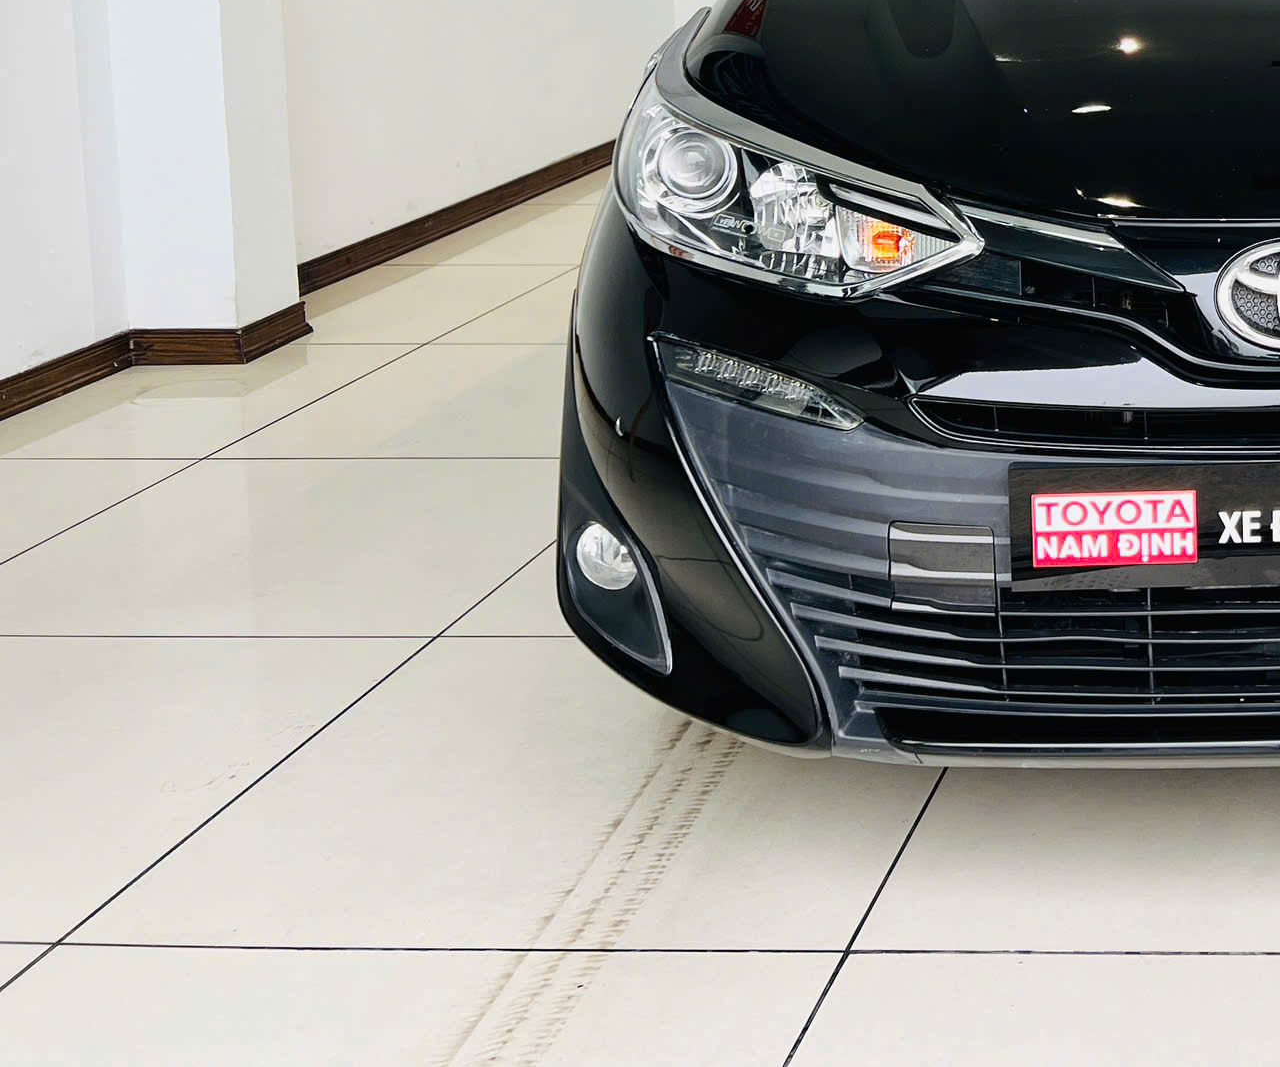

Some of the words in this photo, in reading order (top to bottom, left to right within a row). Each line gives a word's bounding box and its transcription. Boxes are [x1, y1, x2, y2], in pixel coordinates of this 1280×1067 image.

[1037, 499, 1191, 526] TOYOTA
[1218, 510, 1262, 544] XE
[1037, 534, 1109, 560] NAM
[1117, 532, 1194, 562] ĐỊNH
